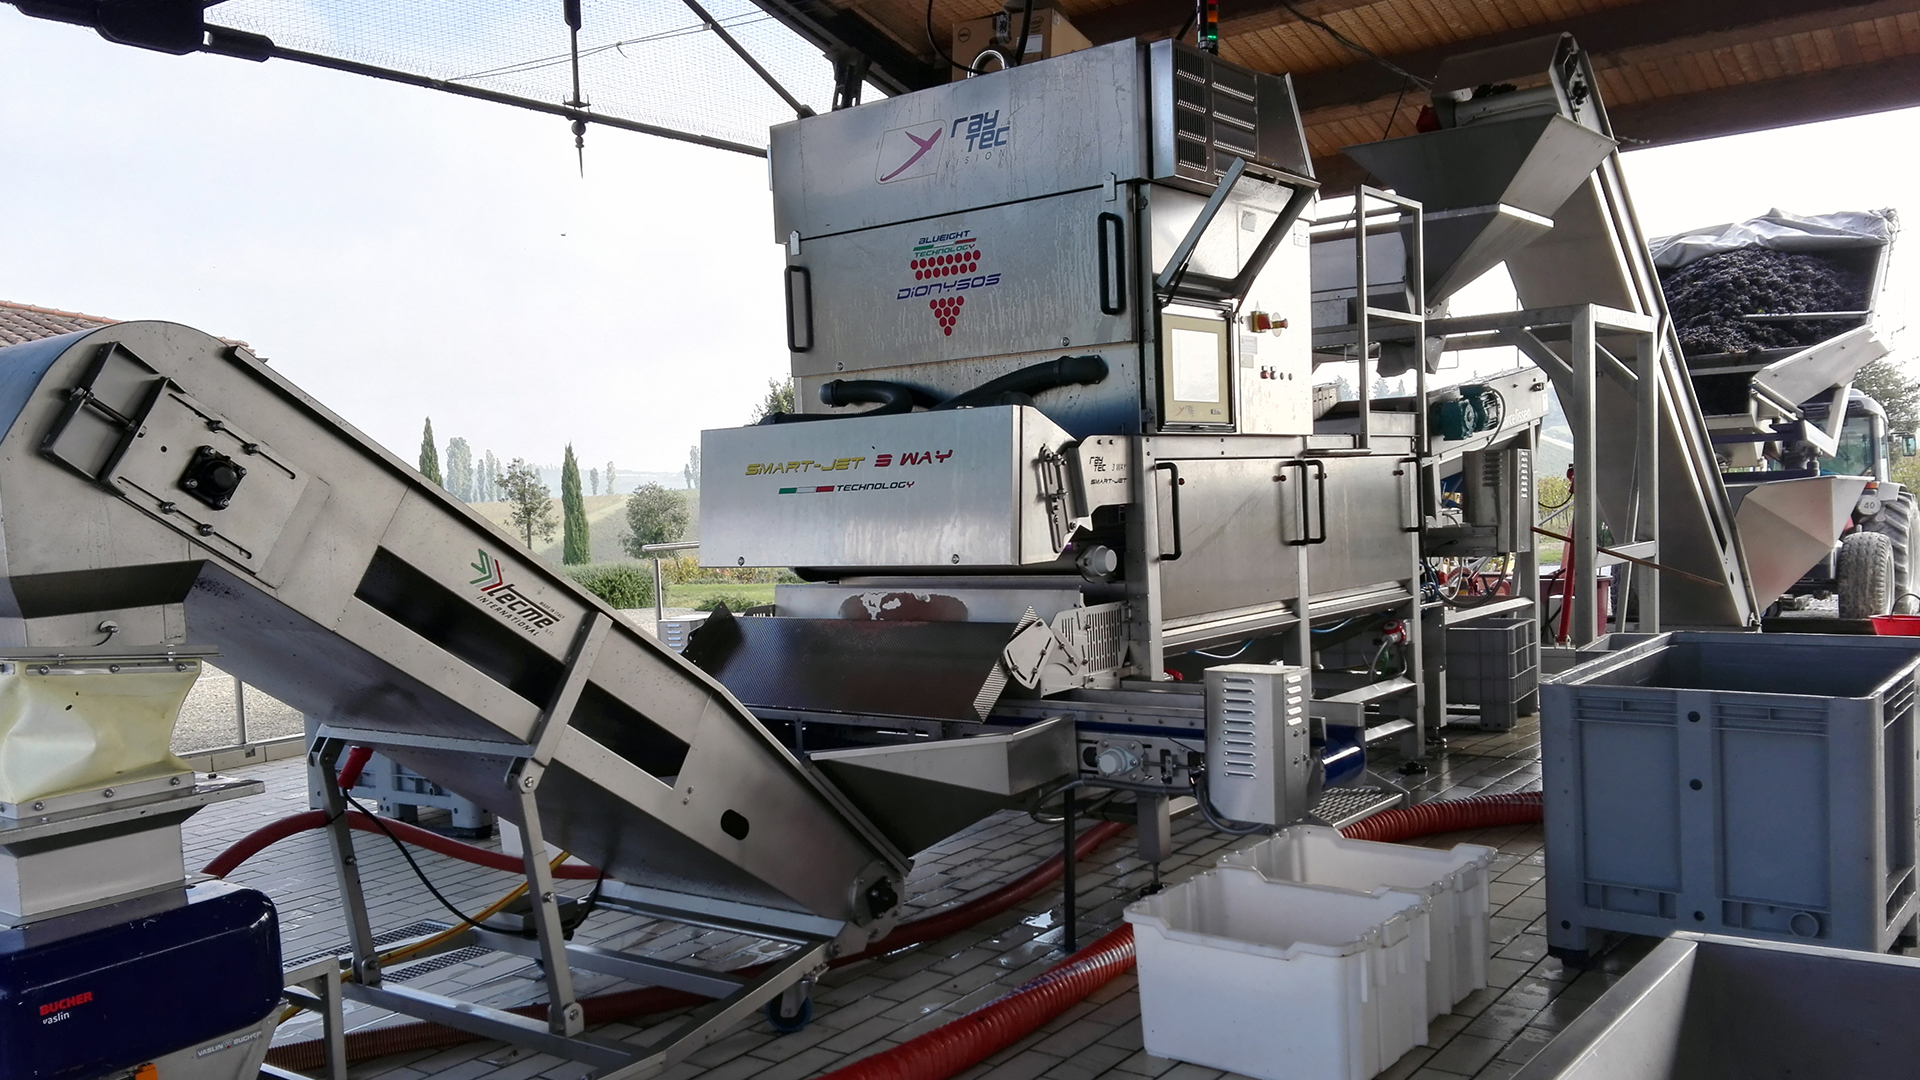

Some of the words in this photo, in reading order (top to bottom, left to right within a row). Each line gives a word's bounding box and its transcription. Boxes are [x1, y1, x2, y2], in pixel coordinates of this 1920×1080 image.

[918, 229, 971, 245] BLUEIGHT
[914, 243, 976, 258] TECHNOLOGY
[745, 456, 866, 476] SMART-JET
[874, 453, 893, 468] 3
[899, 449, 954, 466] WAY
[836, 481, 916, 492] TECHNOLOGY
[1090, 477, 1127, 485] SMART-JET
[1864, 501, 1875, 509] 40
[476, 595, 540, 636] INTERNATIONAL
[39, 991, 93, 1016] BUCHER
[42, 1012, 70, 1025] vaslin
[197, 1043, 224, 1057] VASLIN
